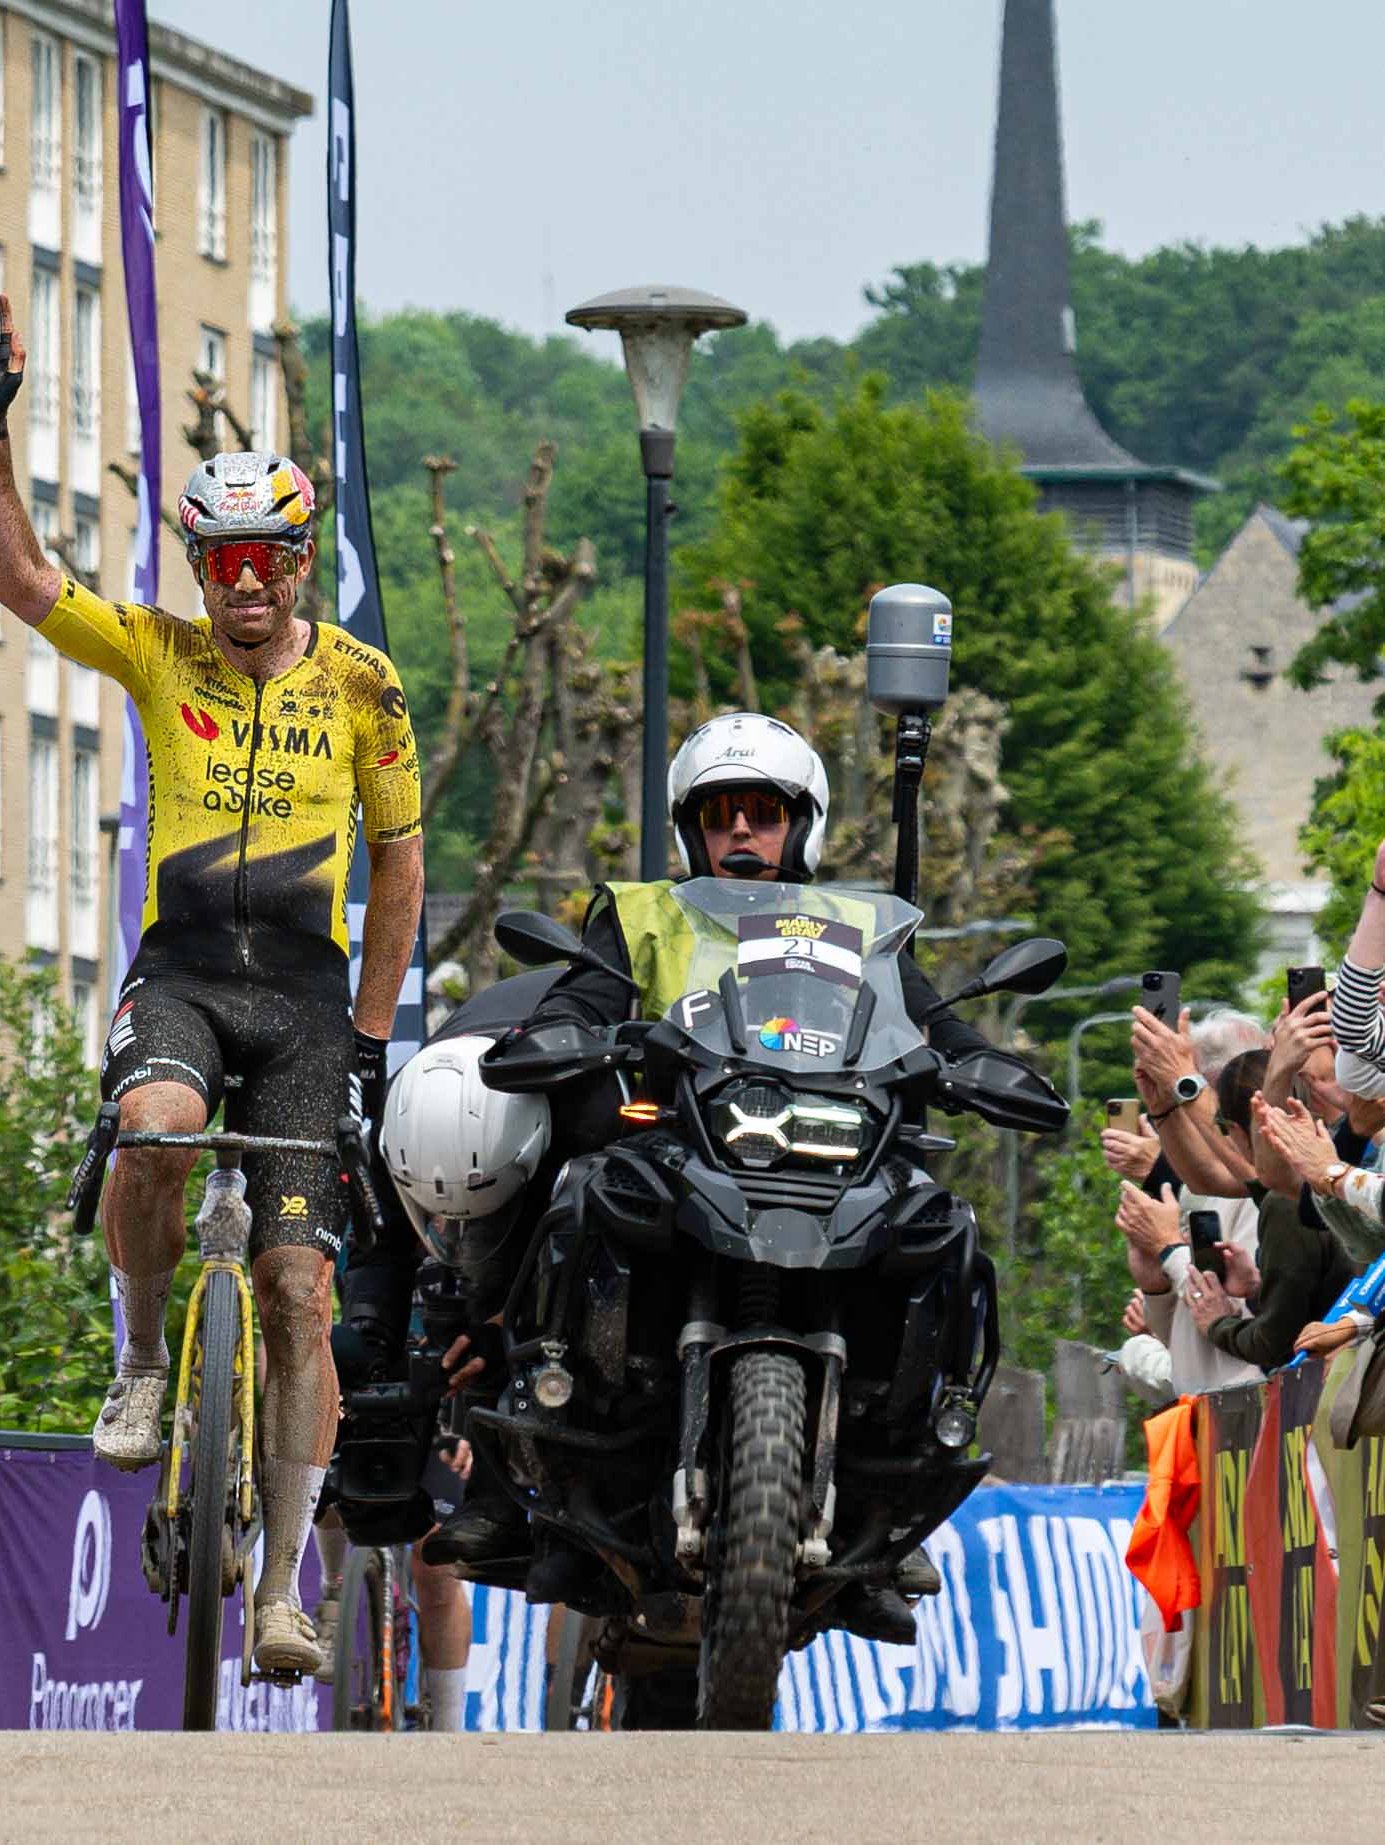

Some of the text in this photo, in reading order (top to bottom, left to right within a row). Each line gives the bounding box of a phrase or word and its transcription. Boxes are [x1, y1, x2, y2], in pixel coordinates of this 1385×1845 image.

[232, 719, 332, 760] VISMA
[715, 746, 757, 760] Arai
[206, 756, 295, 791] lease
[775, 918, 827, 935] MARLY
[783, 938, 819, 959] 21
[682, 990, 711, 1028] F
[784, 1032, 836, 1058] NEP
[315, 1227, 342, 1253] nimb
